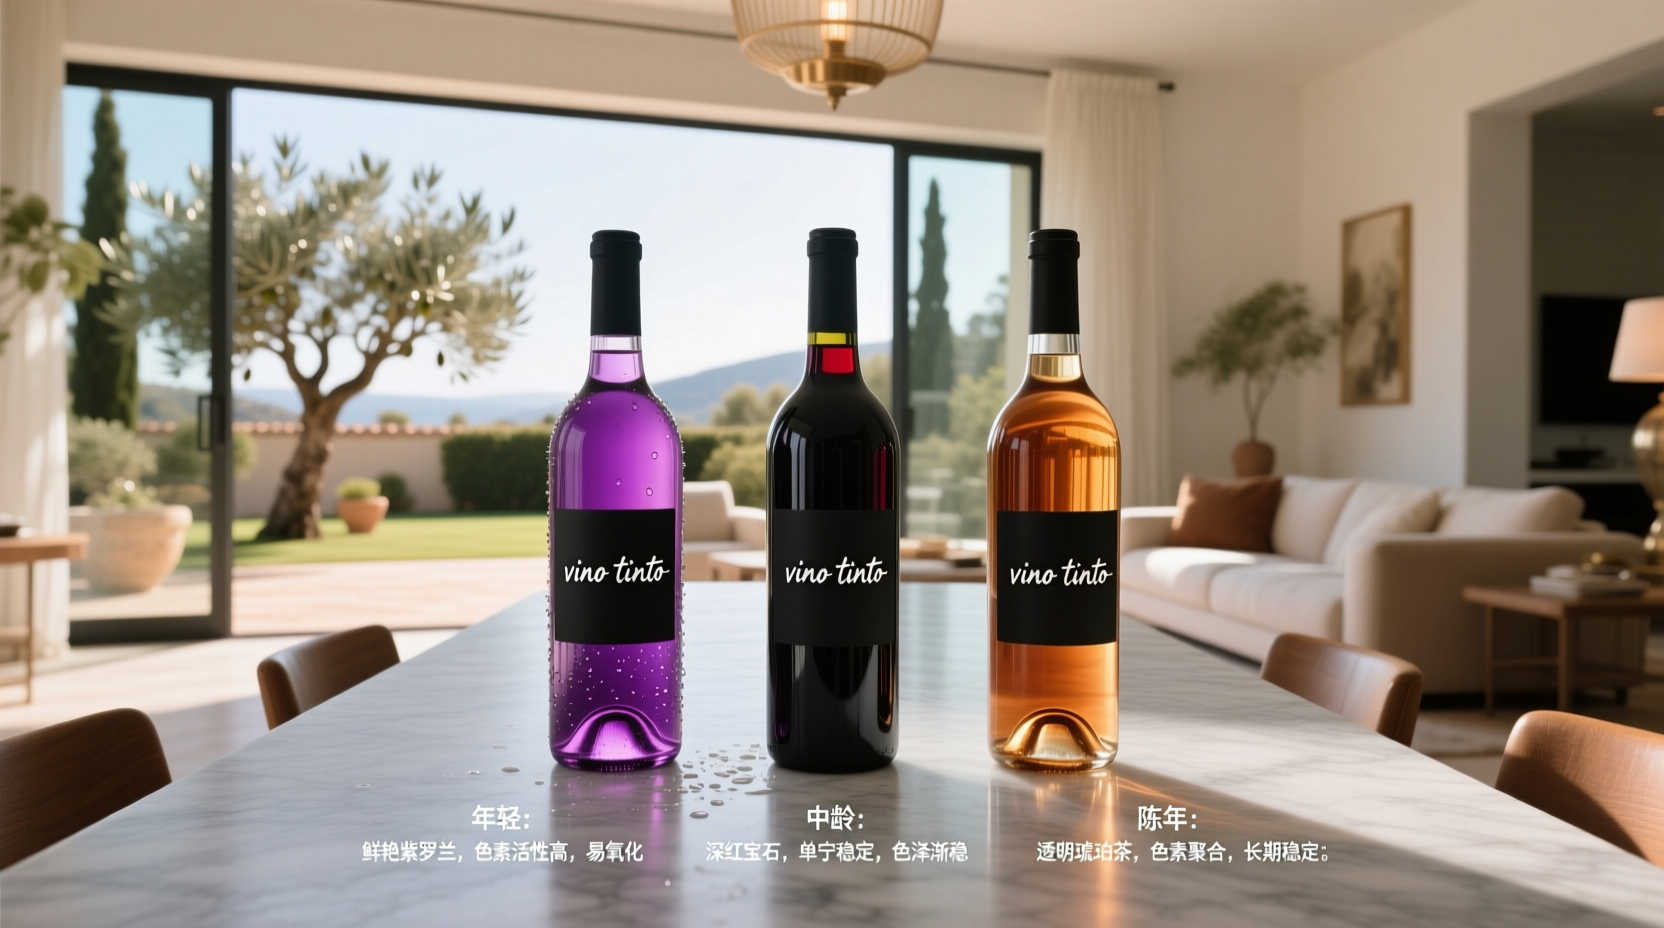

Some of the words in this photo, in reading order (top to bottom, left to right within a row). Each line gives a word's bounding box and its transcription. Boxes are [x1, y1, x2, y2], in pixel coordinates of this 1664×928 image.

[564, 559, 610, 584] vino
[612, 555, 671, 584] tinto
[785, 559, 832, 584] vino
[834, 556, 891, 584] tinto
[1010, 561, 1057, 585] vino
[1061, 557, 1114, 587] tinto
